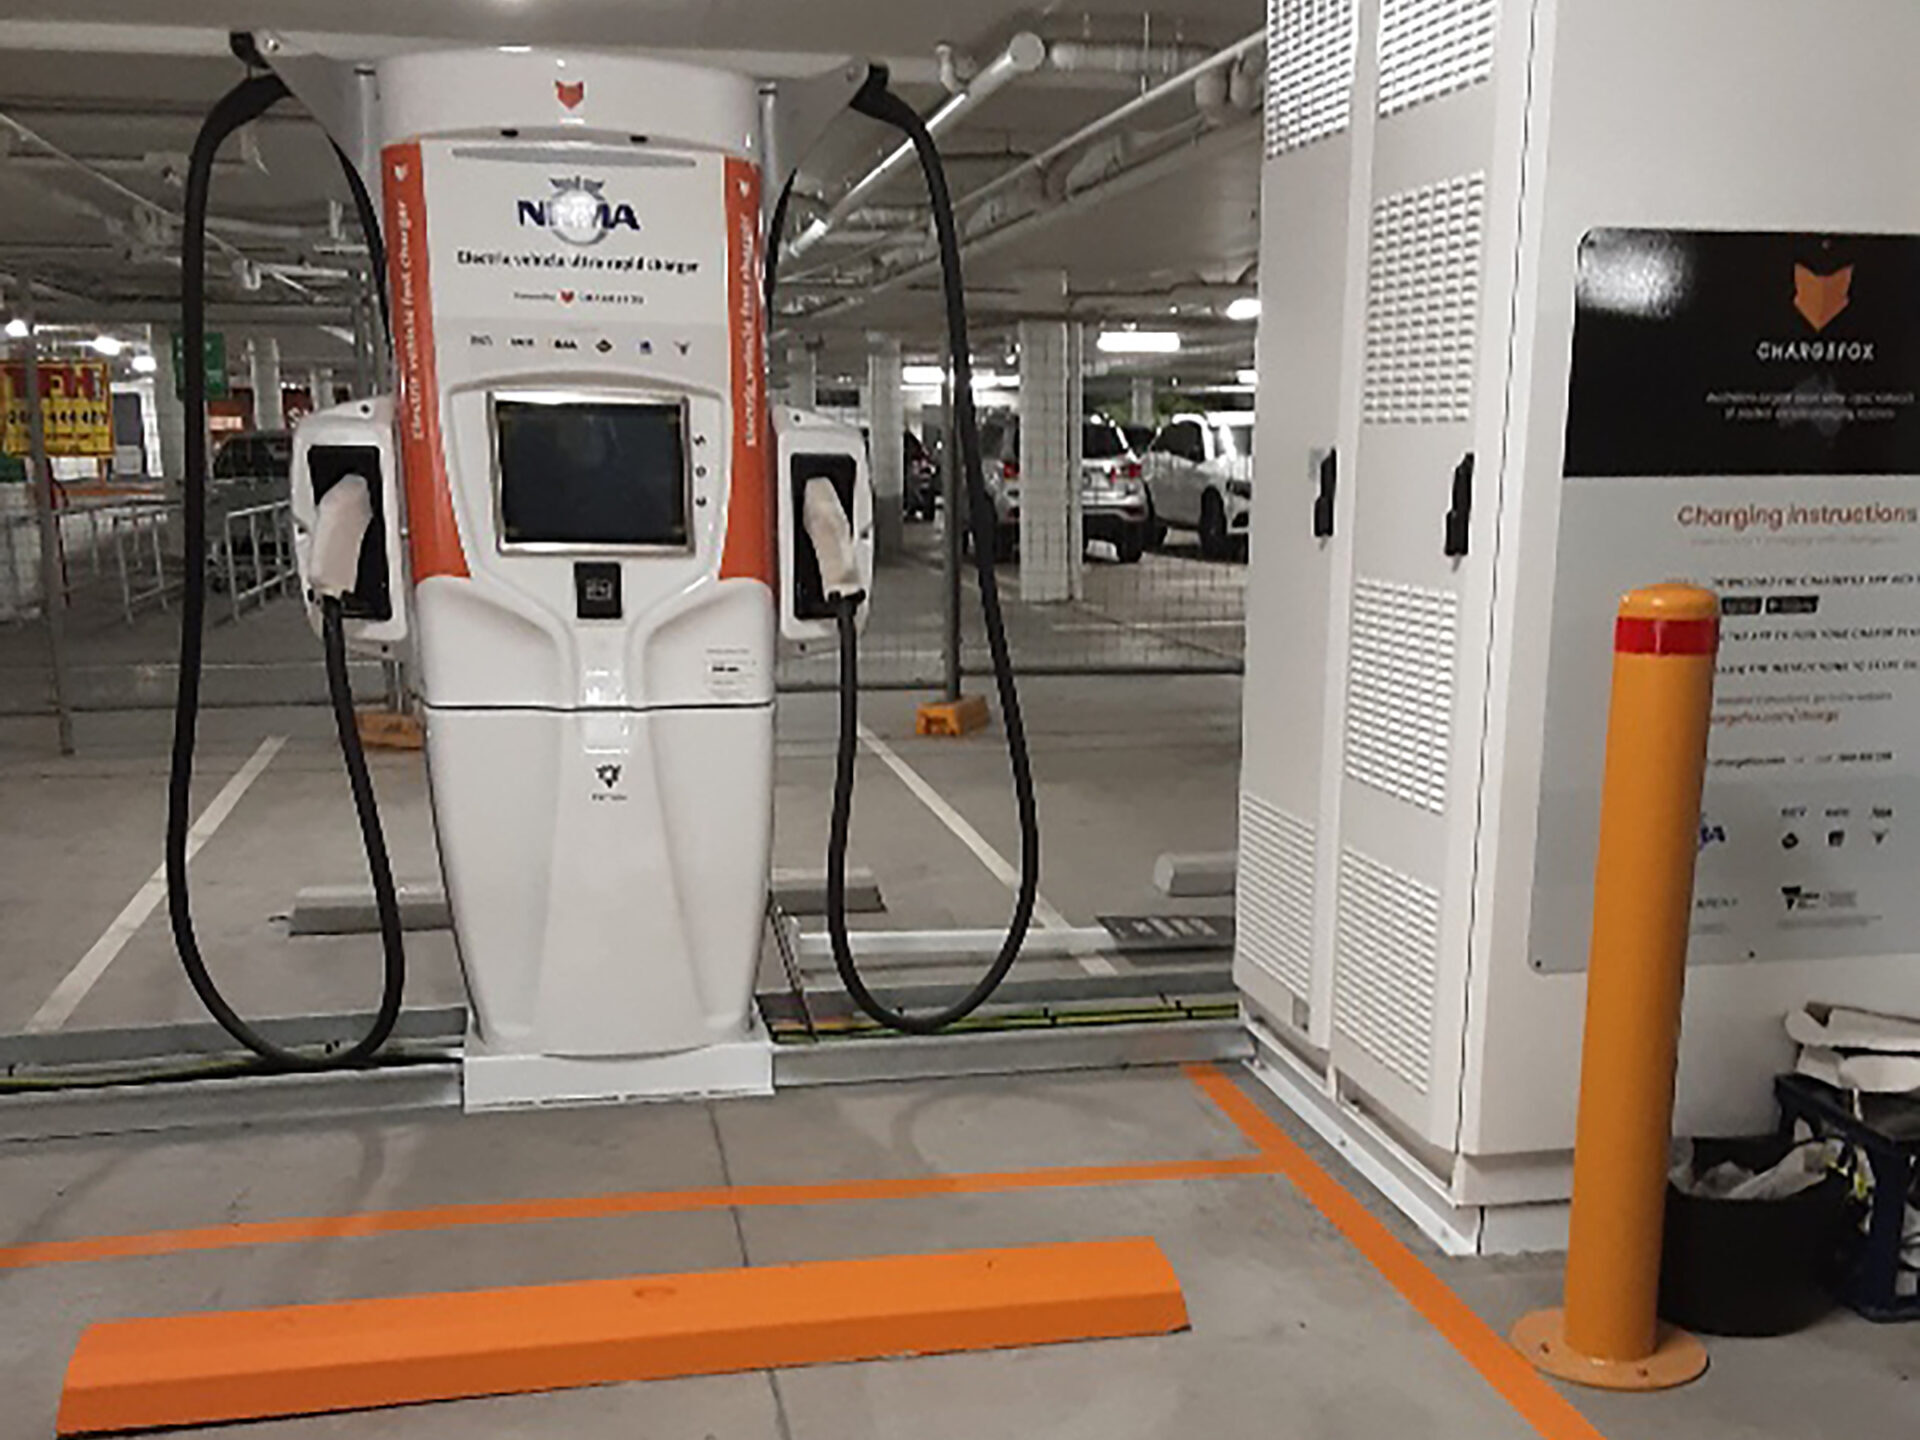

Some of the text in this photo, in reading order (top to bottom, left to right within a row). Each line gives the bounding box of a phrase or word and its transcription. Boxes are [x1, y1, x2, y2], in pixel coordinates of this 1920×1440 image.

[1757, 342, 1875, 361] CHARGEFOX
[1677, 501, 1919, 532] Charging instructions
